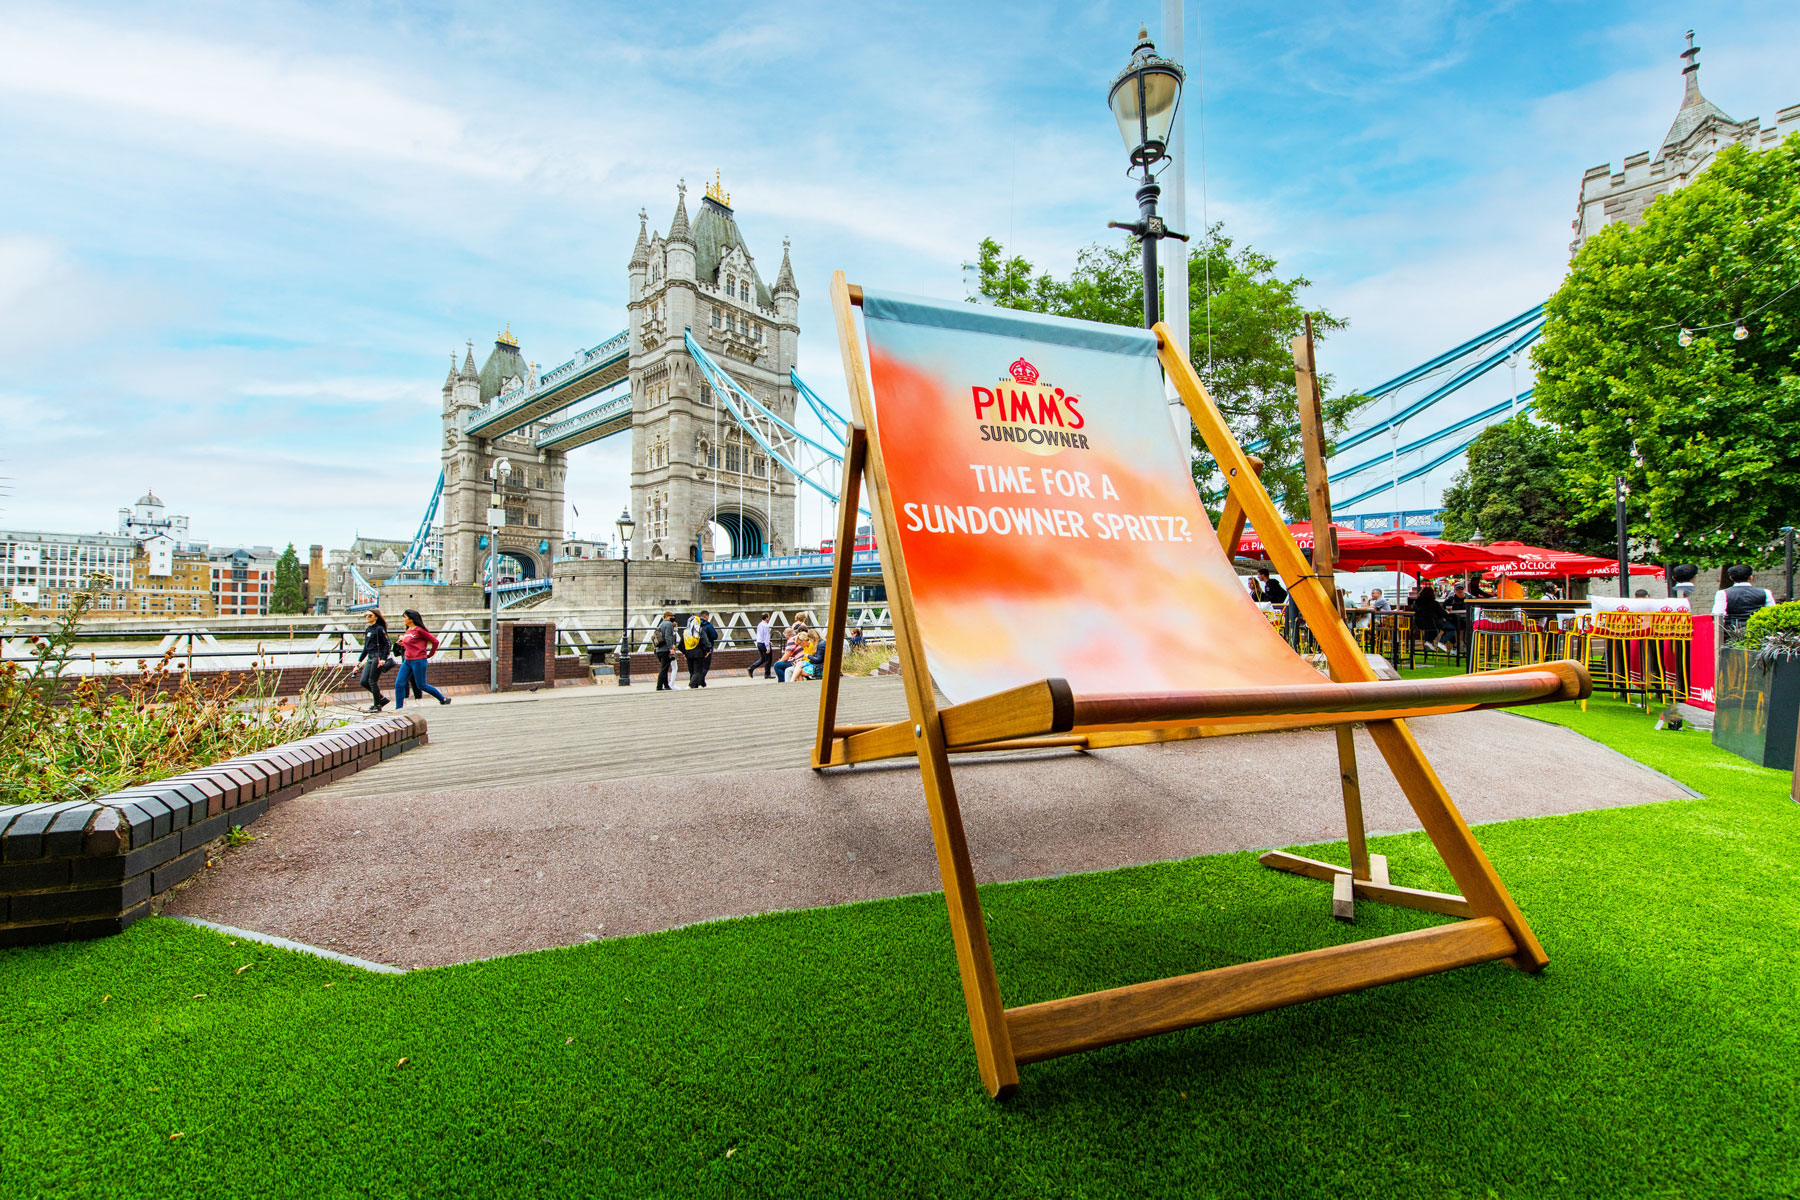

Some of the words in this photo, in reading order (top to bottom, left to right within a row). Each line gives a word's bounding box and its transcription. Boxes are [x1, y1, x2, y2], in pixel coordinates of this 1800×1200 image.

[971, 386, 1085, 429] PIMM'S
[980, 424, 1090, 450] SUNDOWNER
[969, 464, 1036, 494] TIME
[1041, 468, 1096, 499] FOR
[1102, 474, 1120, 501] A
[903, 503, 1090, 539] SUNDOWNER
[1092, 512, 1192, 542] SPRITZ?
[1491, 562, 1518, 572] PIMM'S
[1519, 560, 1557, 570] O'CLOCK
